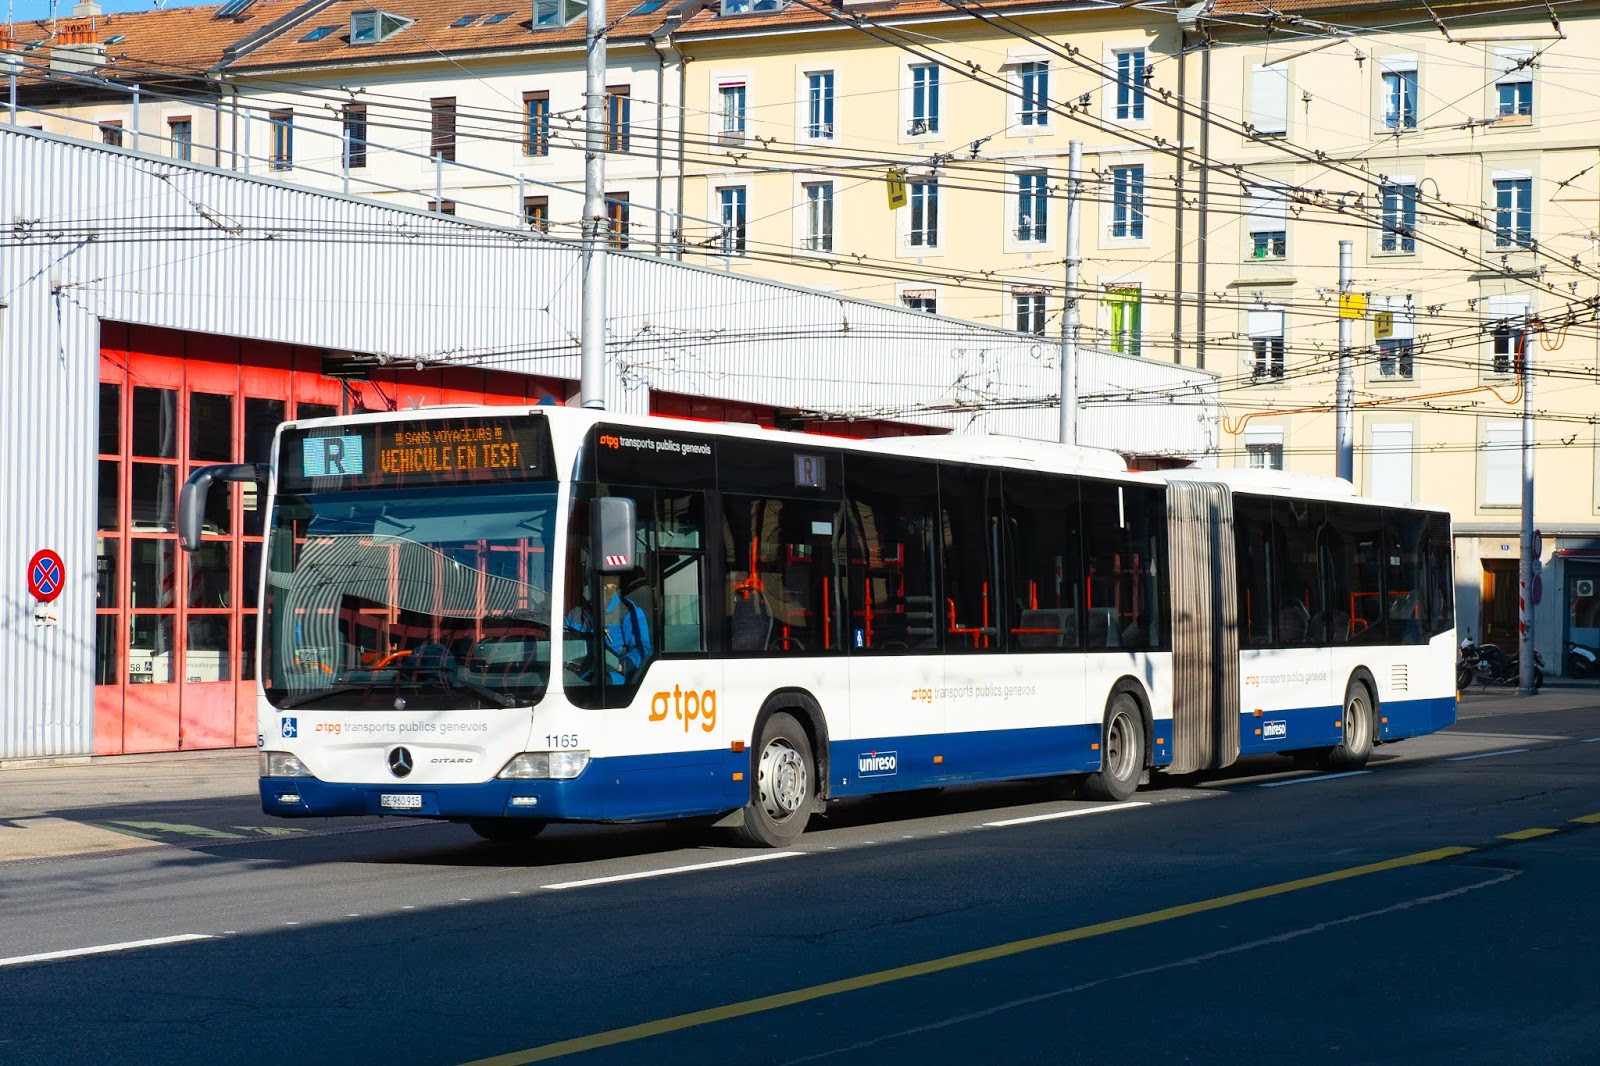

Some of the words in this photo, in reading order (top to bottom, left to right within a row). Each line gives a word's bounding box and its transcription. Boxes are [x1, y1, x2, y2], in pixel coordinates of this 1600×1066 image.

[404, 431, 431, 445] SANS
[433, 428, 492, 443] VOYAGEURS
[620, 436, 655, 450] transports
[656, 439, 681, 453] publics
[681, 443, 711, 456] genevois
[324, 438, 345, 474] R
[381, 446, 452, 473] VEHICULE
[457, 445, 477, 470] EN
[482, 442, 519, 468] TEST
[935, 684, 974, 702] transports
[975, 683, 1002, 700] publics
[1004, 685, 1036, 700] genevois
[673, 683, 717, 733] tpg
[324, 722, 341, 735] tpg
[344, 721, 396, 735] transports
[399, 721, 436, 735] publics
[439, 722, 488, 735] genevois
[1264, 722, 1286, 736] unireso
[545, 734, 579, 748] 1165
[859, 754, 897, 772] unireso
